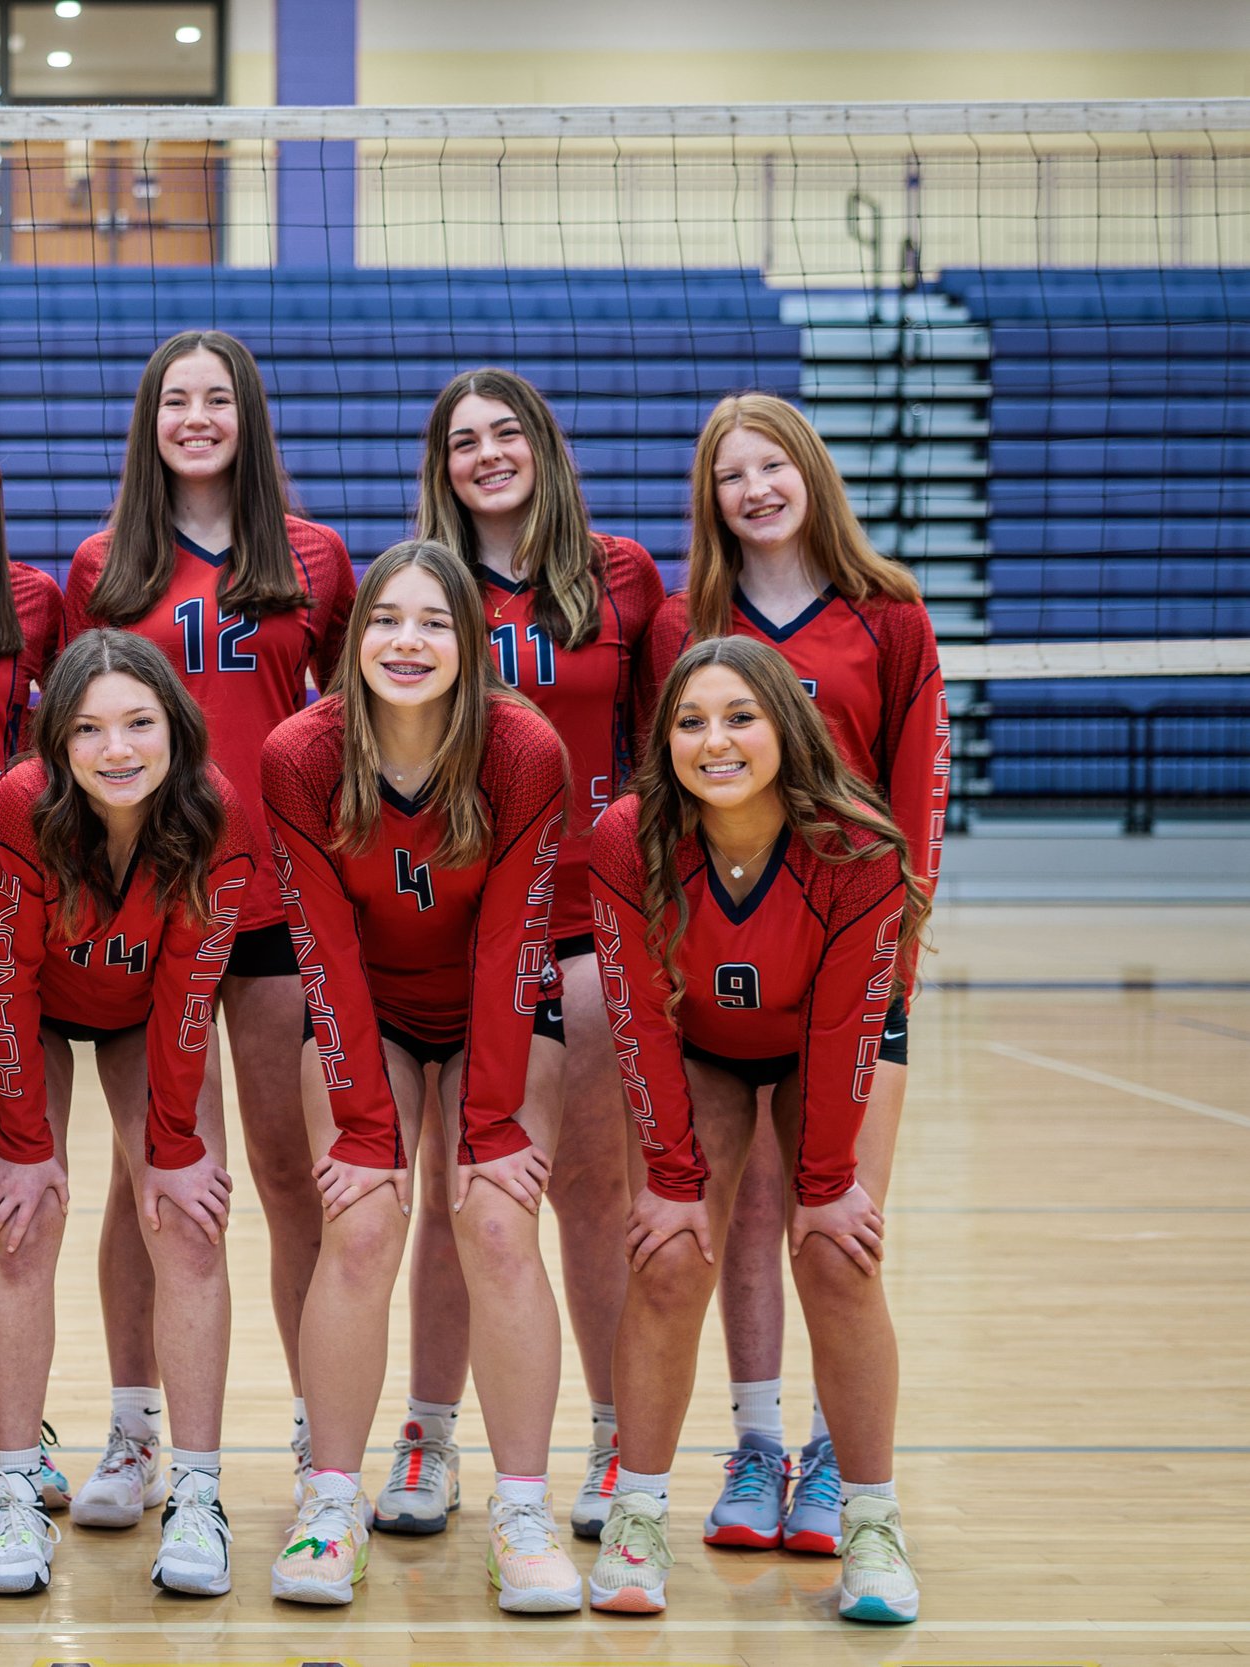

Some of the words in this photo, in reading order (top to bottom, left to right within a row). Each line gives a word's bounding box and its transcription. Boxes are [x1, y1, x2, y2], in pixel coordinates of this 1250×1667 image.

[174, 597, 258, 674] 12
[490, 623, 556, 688] 11
[394, 848, 435, 912] 4
[177, 876, 247, 1054] UNITED
[713, 963, 761, 1009] 9
[590, 893, 665, 1151] ROANOKE
